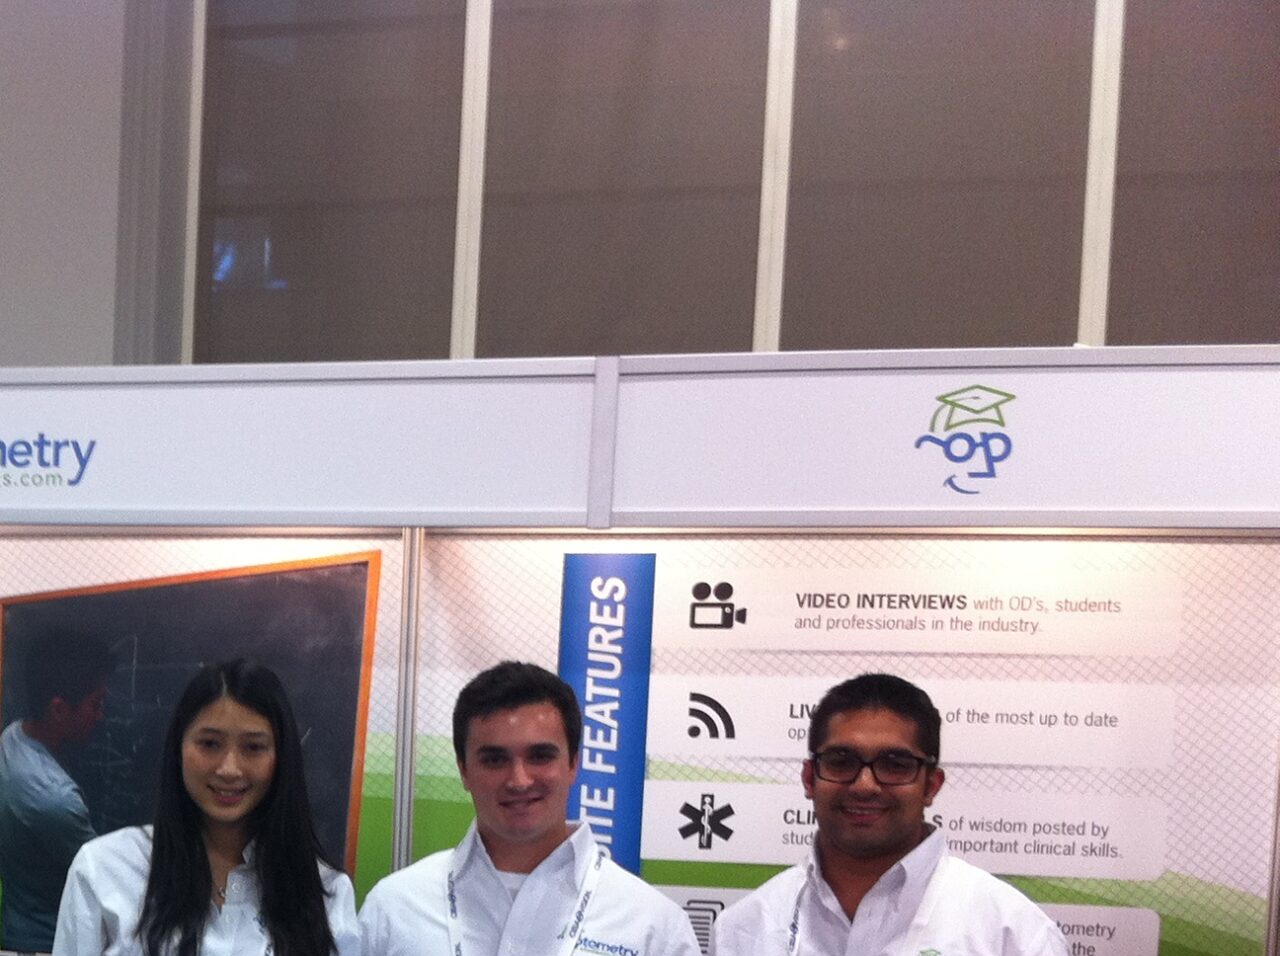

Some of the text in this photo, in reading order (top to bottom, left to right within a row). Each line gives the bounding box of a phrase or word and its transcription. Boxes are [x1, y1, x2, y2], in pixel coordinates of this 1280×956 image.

[795, 593, 850, 610] VIDEO
[856, 593, 968, 611] INTERVIEWS
[973, 597, 1004, 611] with
[1055, 597, 1122, 613] students
[794, 615, 1043, 635] and professionals in the industry.
[582, 576, 627, 774] FEATURES
[789, 703, 1119, 728] LIV of the most up to date
[949, 815, 964, 831] of
[969, 817, 1028, 834] wisdom
[1032, 819, 1087, 838] posted
[1091, 820, 1109, 838] by
[1023, 841, 1076, 858] clinical
